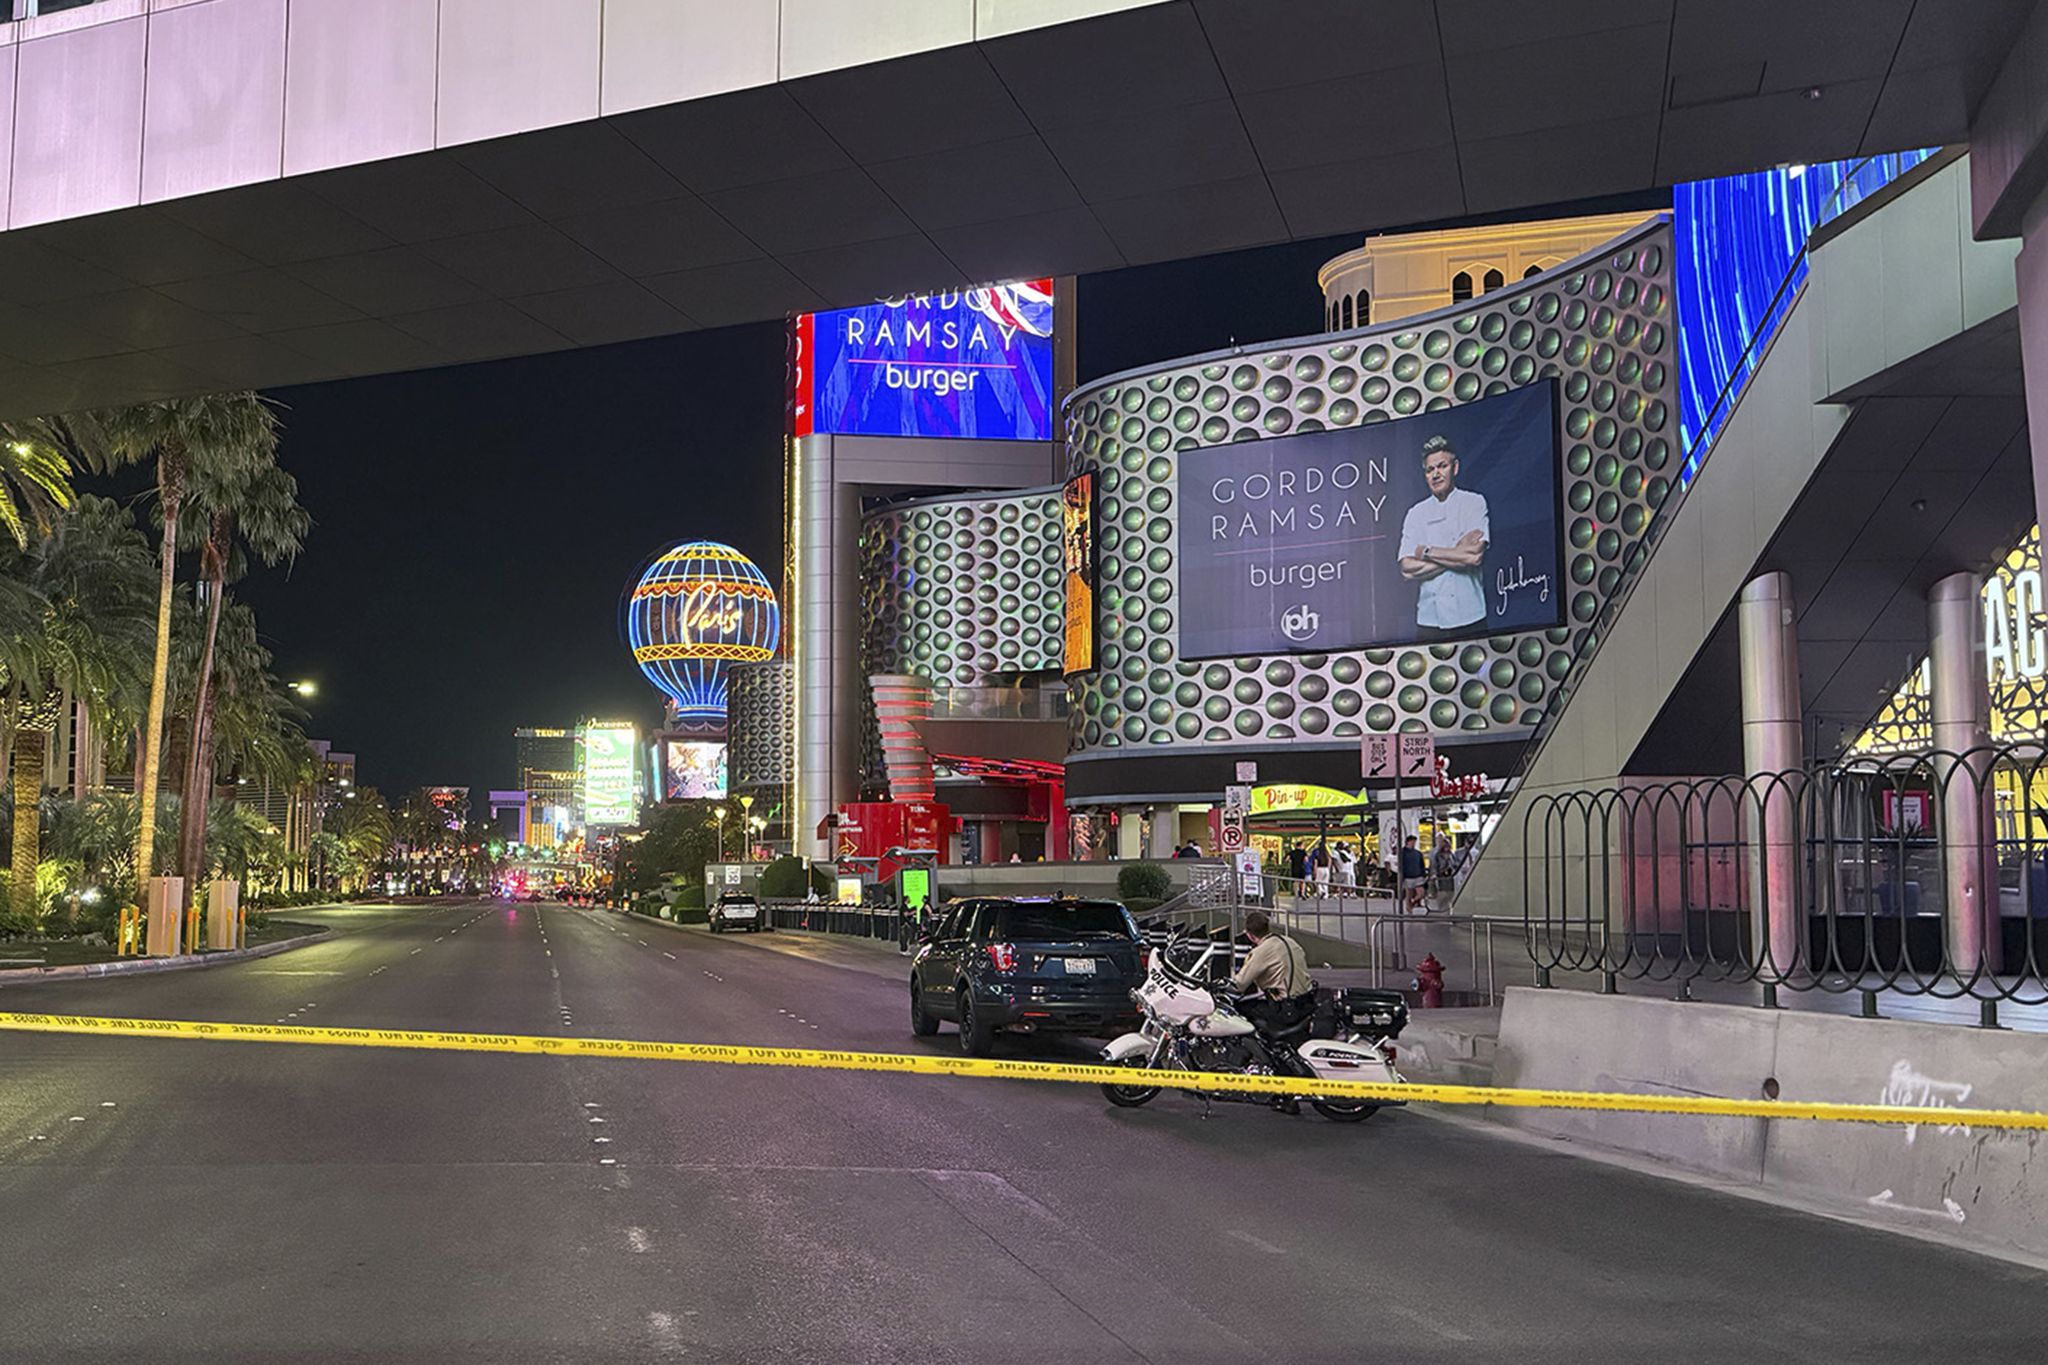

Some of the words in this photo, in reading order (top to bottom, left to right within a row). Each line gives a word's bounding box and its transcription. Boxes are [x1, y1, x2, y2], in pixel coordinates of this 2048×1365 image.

[848, 318, 1017, 351] RAMSAY
[886, 362, 979, 396] burger
[1212, 456, 1388, 504] GORDON
[1212, 495, 1388, 541] RAMSAY
[1249, 560, 1348, 589] burger
[682, 581, 743, 650] Paris
[1403, 748, 1431, 756] NORTH
[1404, 738, 1429, 746] STRIP
[1264, 788, 1308, 809] Pin-up
[1150, 968, 1180, 999] POLICE
